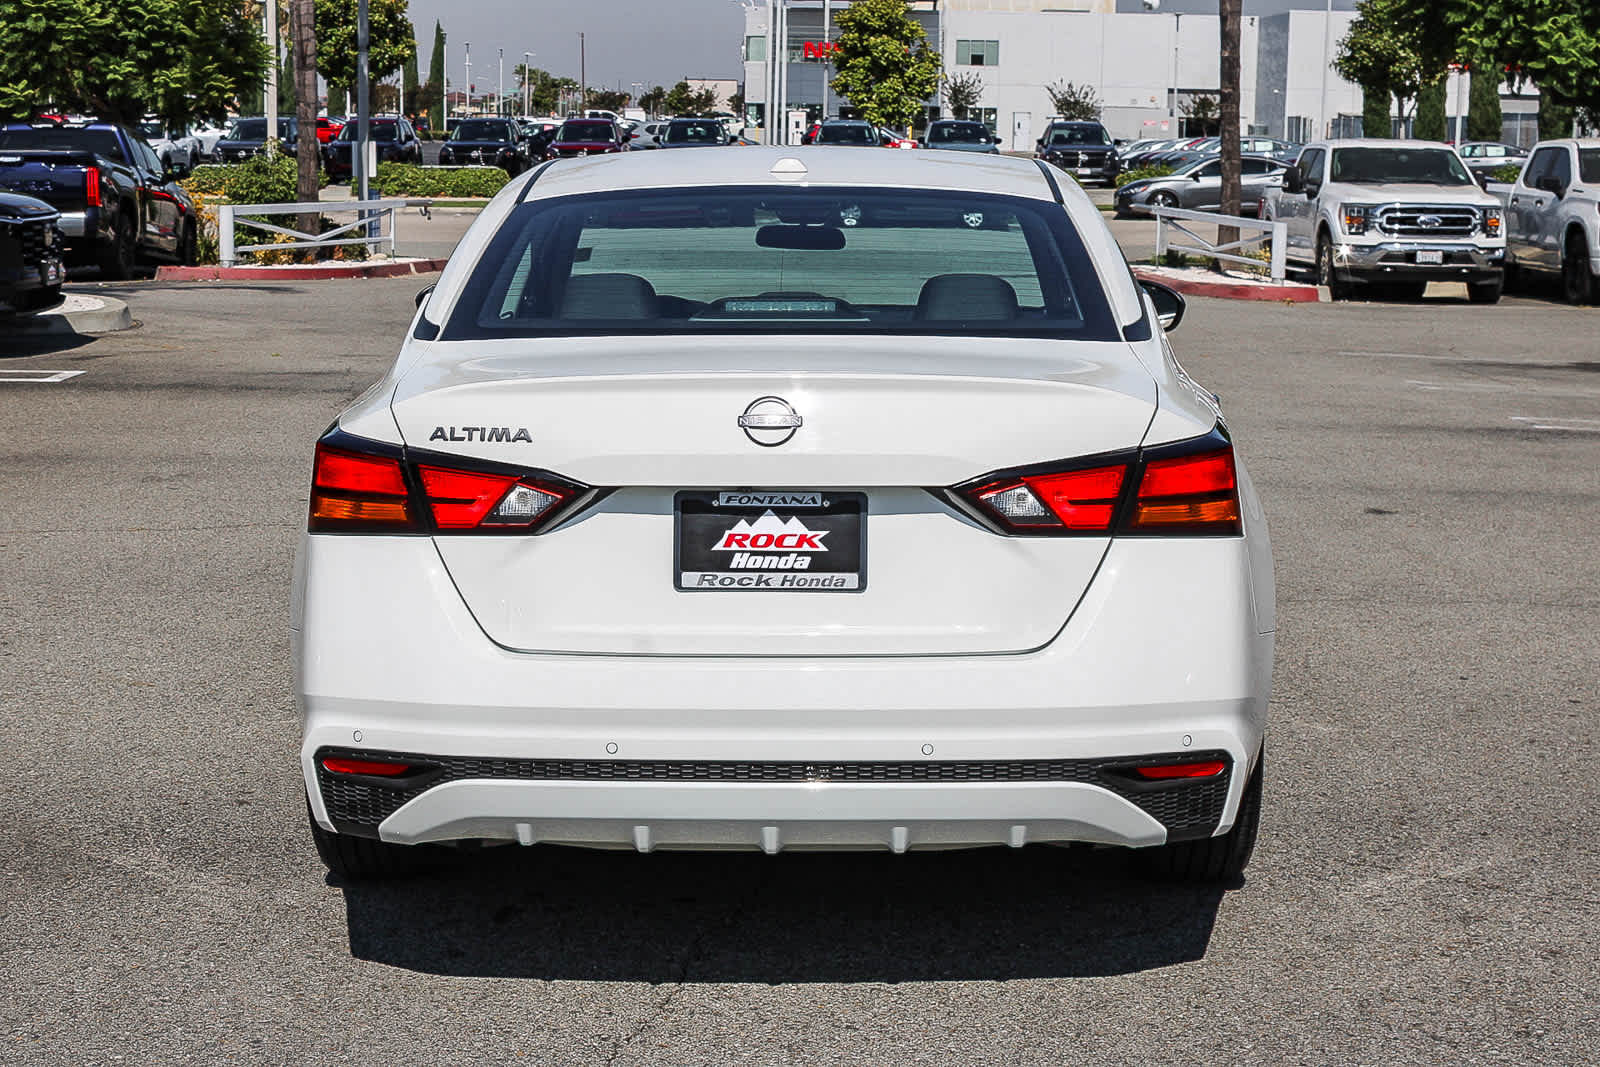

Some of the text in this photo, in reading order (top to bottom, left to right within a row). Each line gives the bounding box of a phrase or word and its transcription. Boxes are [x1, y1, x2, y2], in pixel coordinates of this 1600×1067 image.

[429, 426, 533, 443] ALTIMA
[725, 495, 819, 505] FONTANA
[723, 533, 824, 548] ROCK
[729, 552, 812, 569] Honda
[696, 574, 847, 588] Rock Honda
